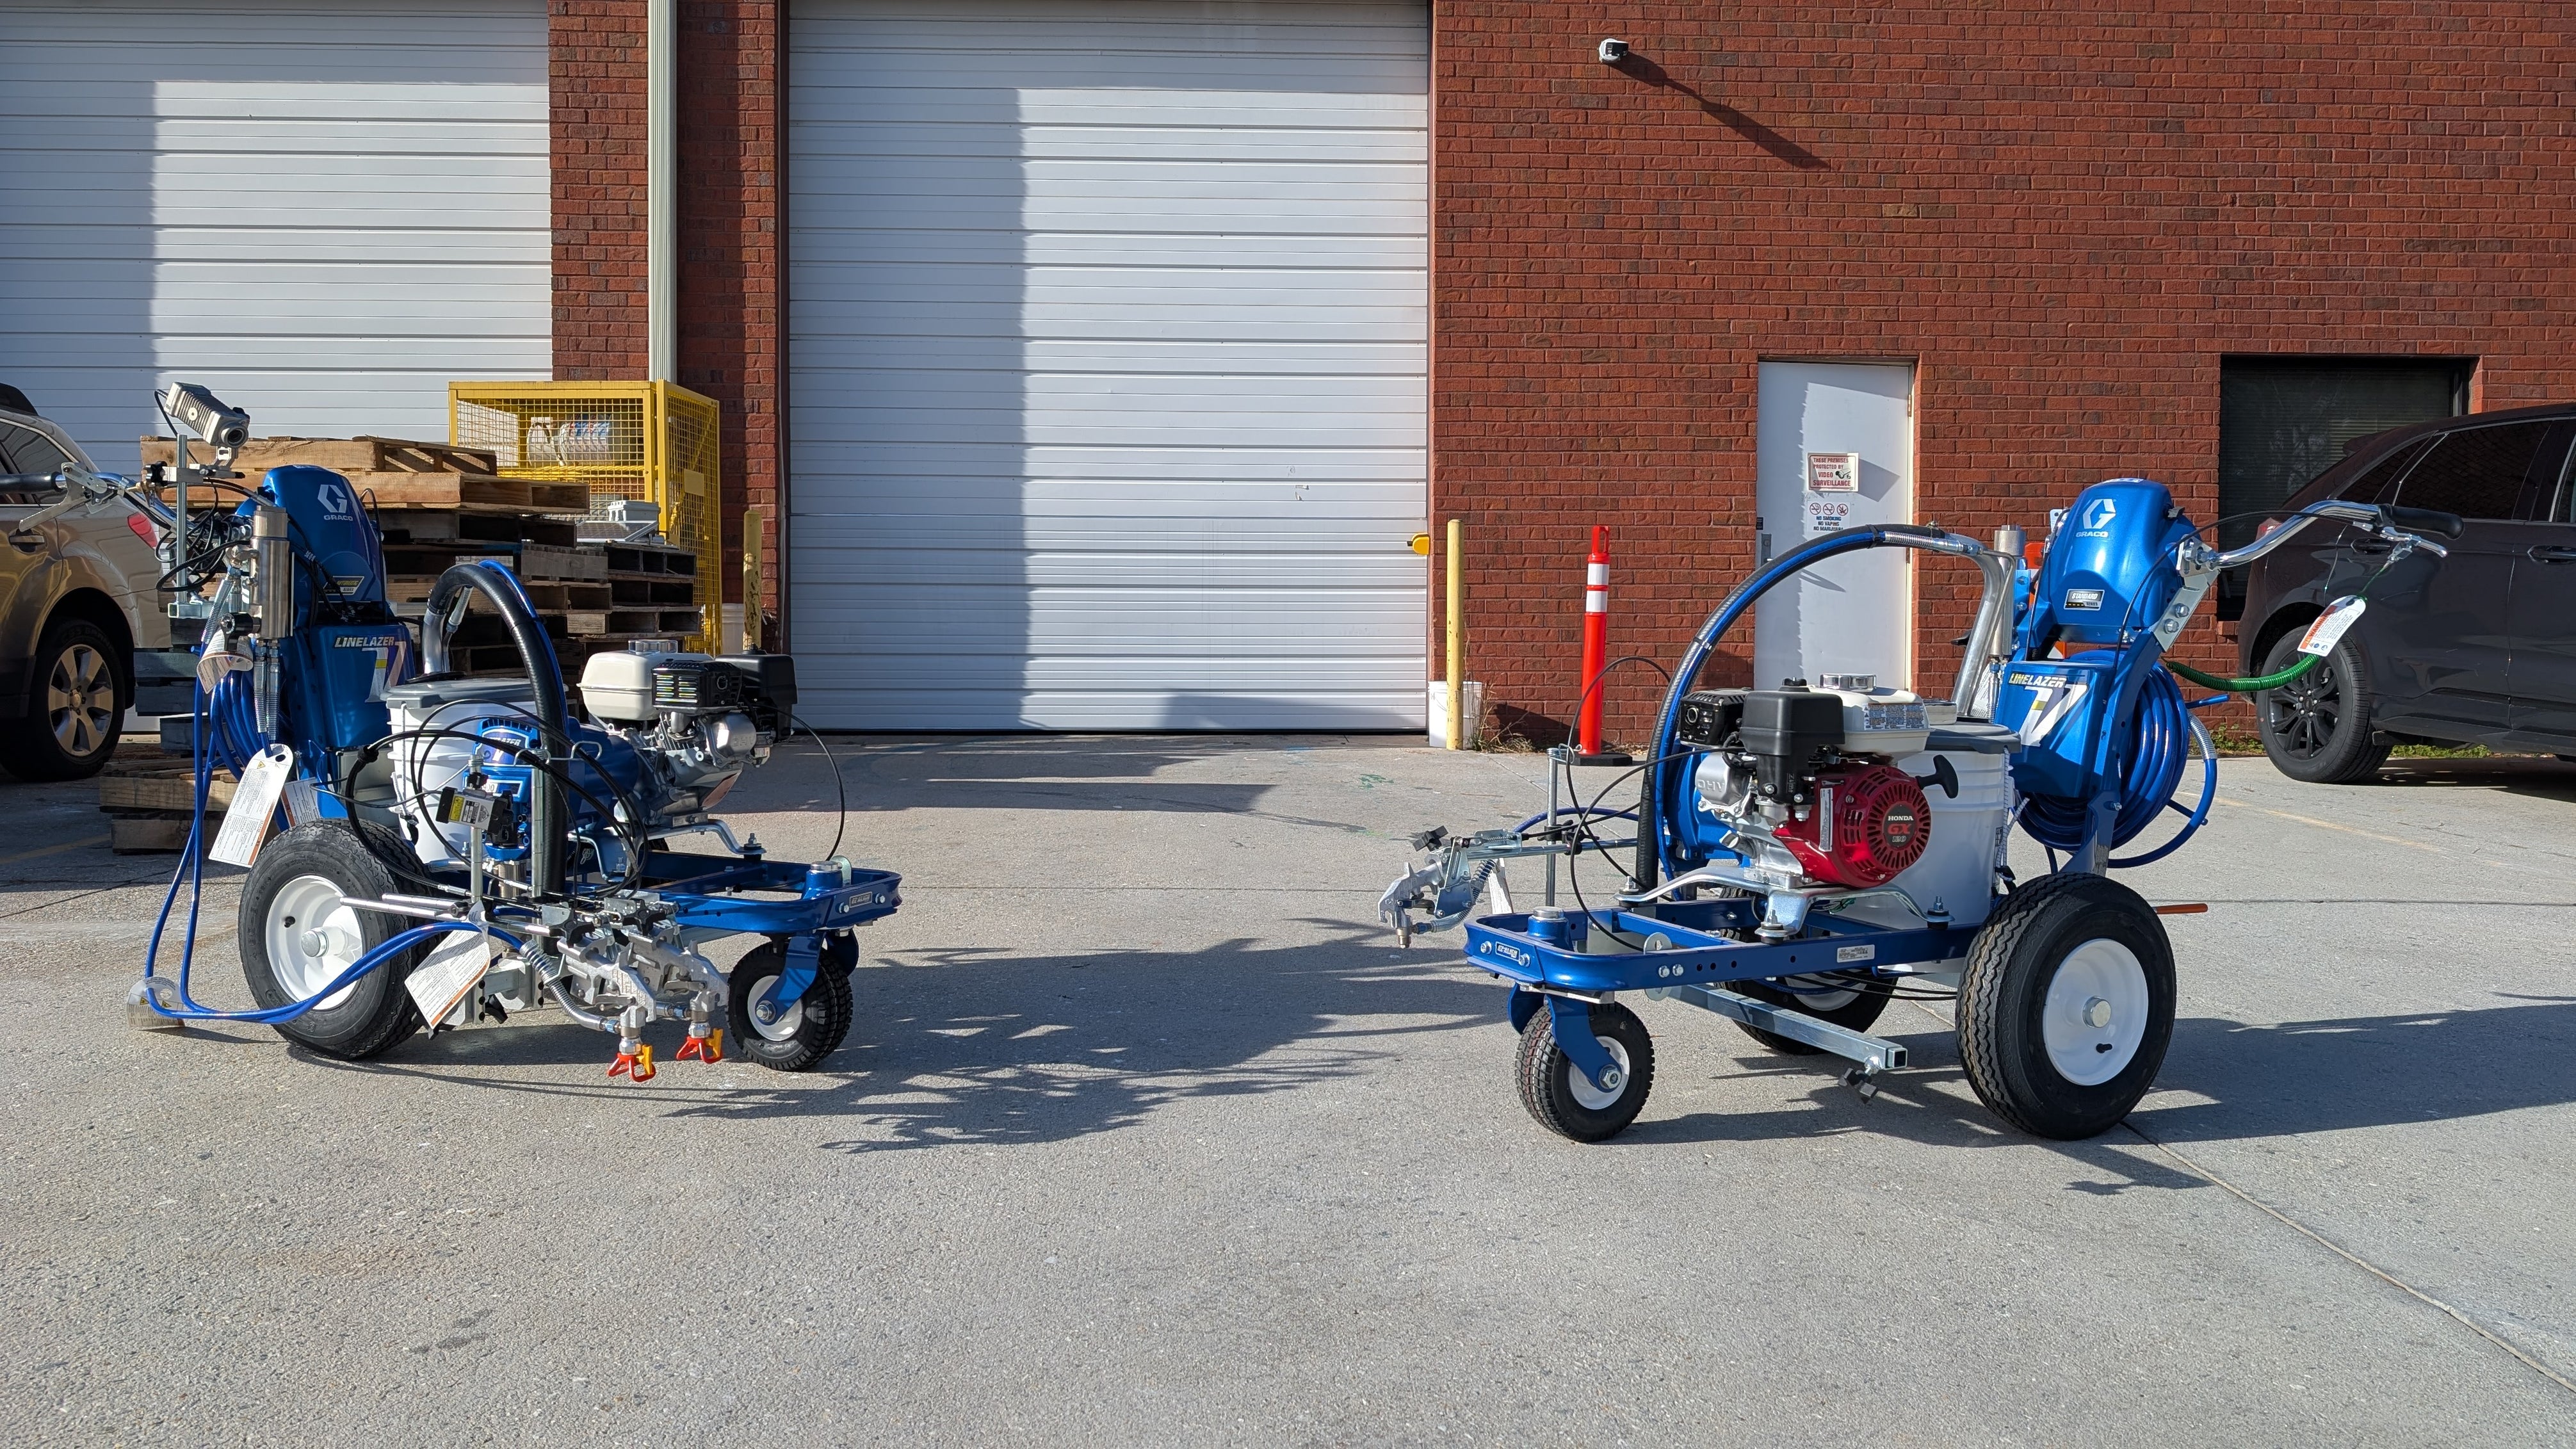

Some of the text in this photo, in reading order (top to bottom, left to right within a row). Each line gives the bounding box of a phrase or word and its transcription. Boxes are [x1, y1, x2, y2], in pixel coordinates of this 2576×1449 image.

[334, 636, 396, 648] LINELAZER
[2008, 673, 2067, 688] LINELAZER
[1697, 779, 1725, 793] OHV
[1888, 823, 1912, 835] GX
